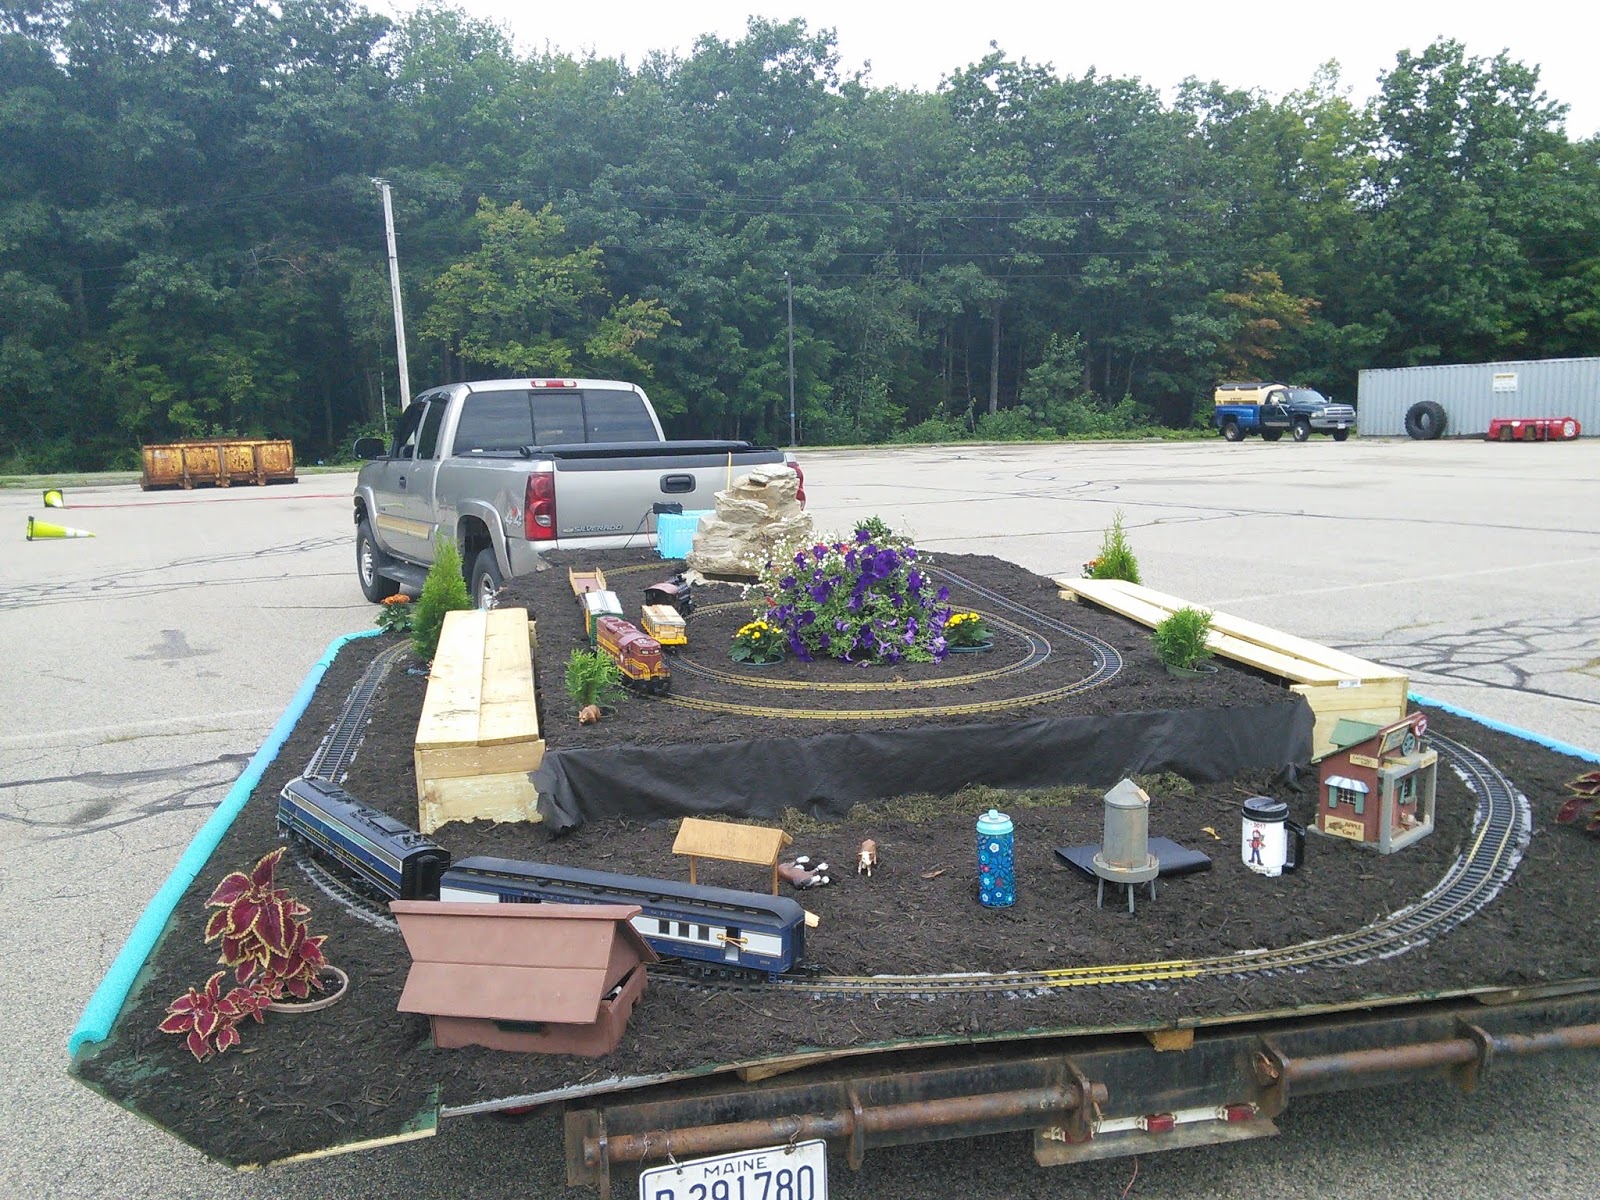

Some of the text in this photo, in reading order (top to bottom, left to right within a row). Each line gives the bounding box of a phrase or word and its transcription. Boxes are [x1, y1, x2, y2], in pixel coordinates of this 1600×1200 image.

[573, 524, 623, 533] SILVERADO
[1344, 821, 1361, 830] APPLE
[704, 1156, 768, 1178] MAINE
